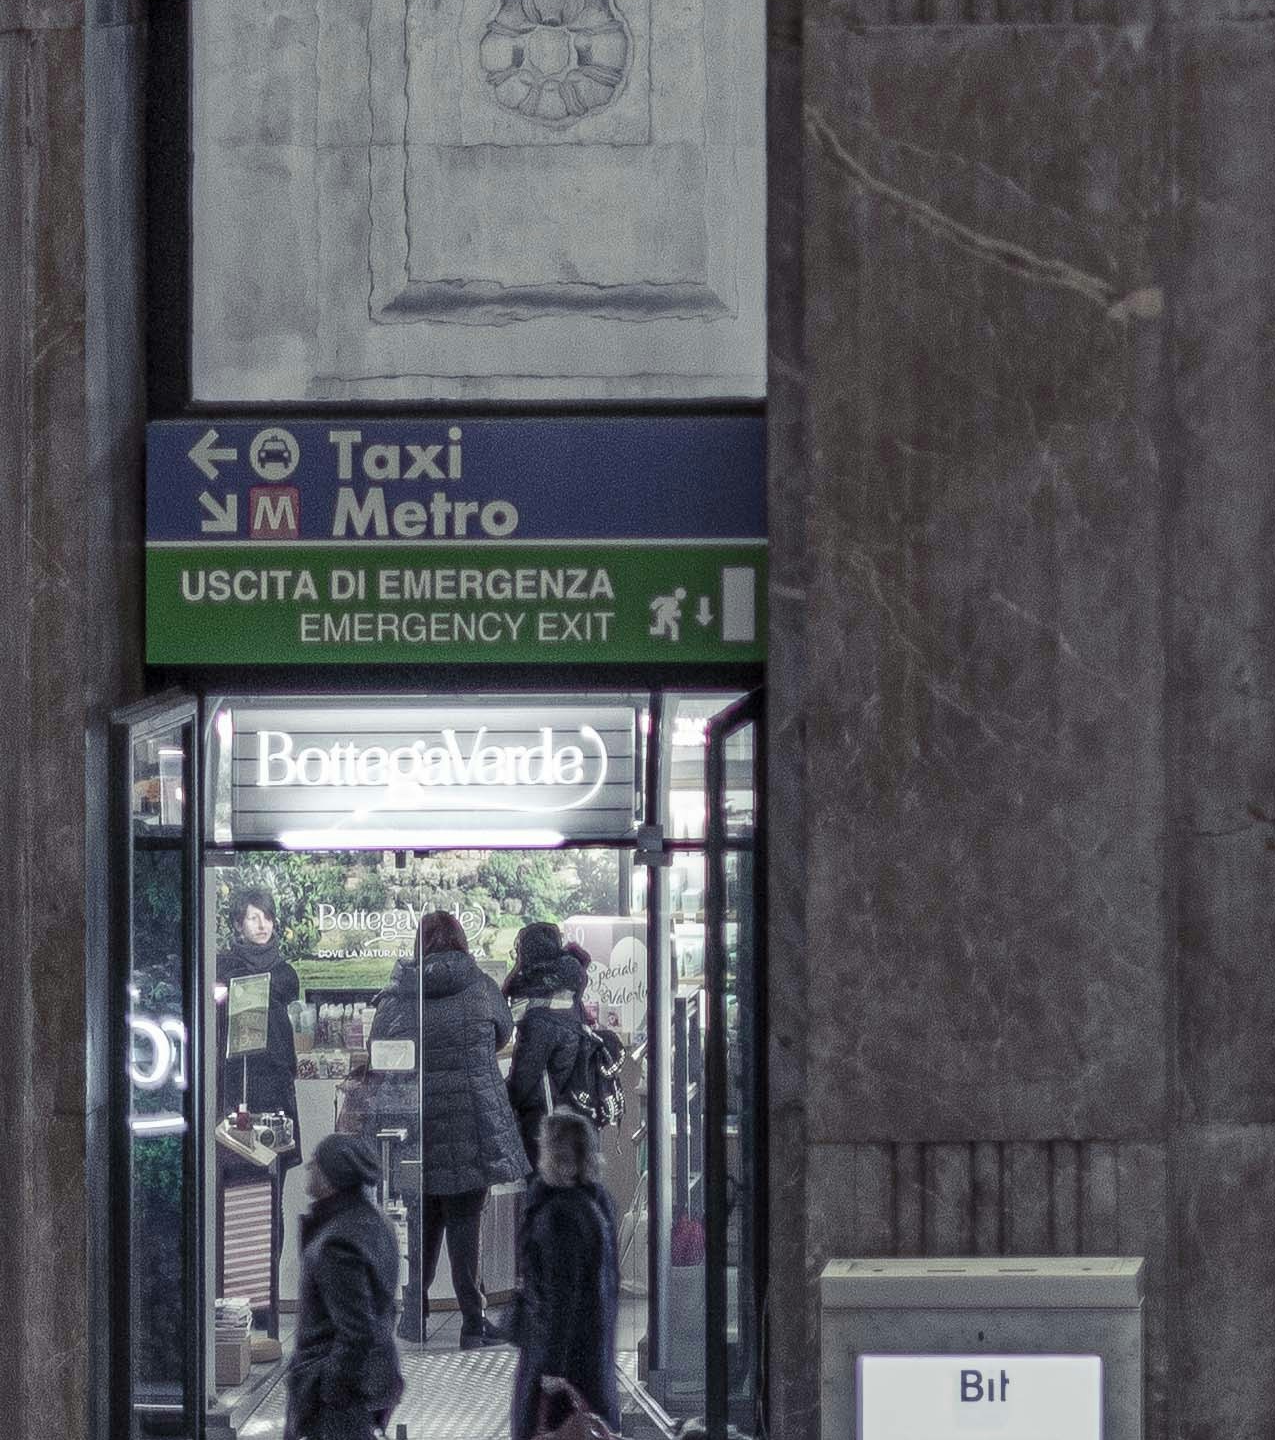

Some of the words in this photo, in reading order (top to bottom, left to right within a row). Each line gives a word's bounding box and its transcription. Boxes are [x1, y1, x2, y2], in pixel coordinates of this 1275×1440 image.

[329, 426, 463, 481] Taxi
[331, 486, 520, 537] Metro
[180, 569, 319, 602] USCITA
[331, 569, 367, 601] DI
[379, 568, 615, 601] EMERGENZA
[300, 612, 522, 643] EMERGENCY
[538, 611, 616, 642] EXIT
[345, 949, 358, 958] LA
[359, 949, 397, 958] NATURA
[960, 1369, 1010, 1403] Bit
